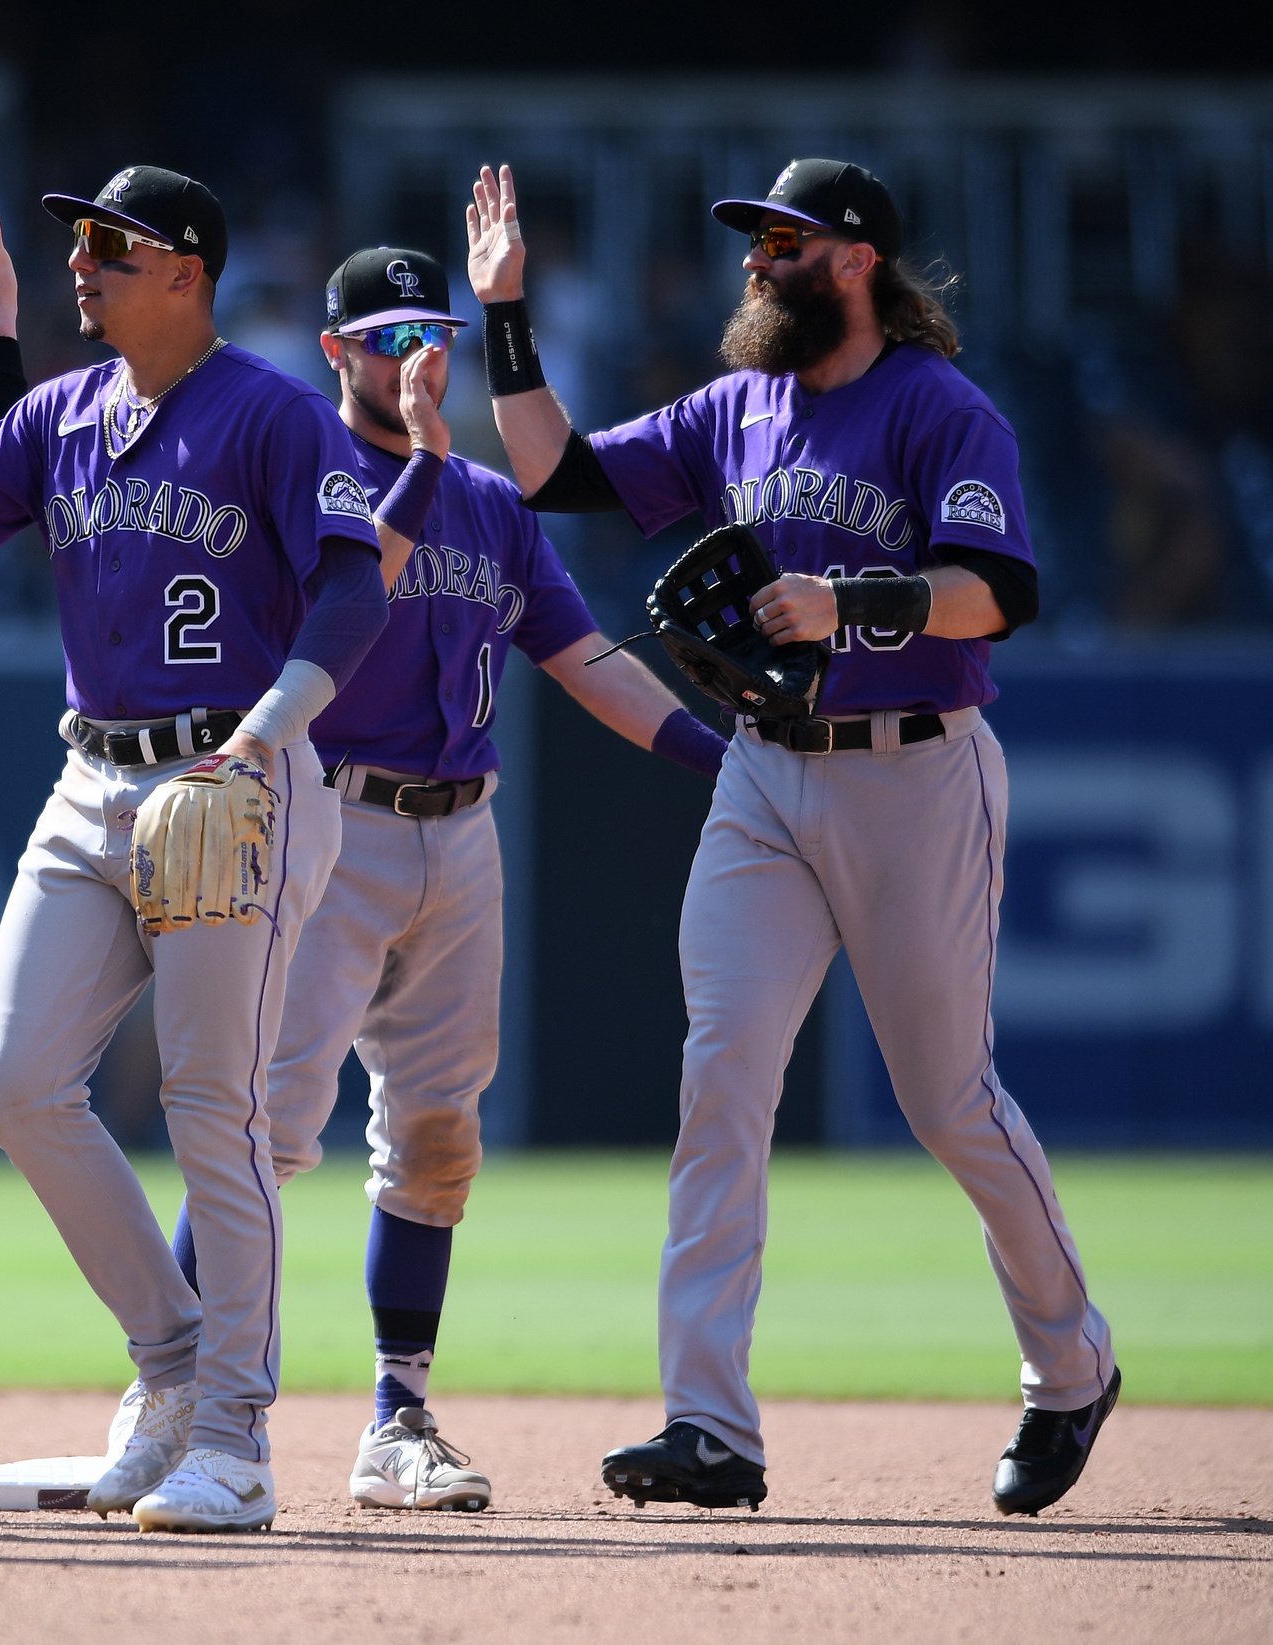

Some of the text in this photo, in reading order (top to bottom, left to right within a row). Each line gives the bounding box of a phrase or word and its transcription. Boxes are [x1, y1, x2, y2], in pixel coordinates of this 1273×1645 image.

[386, 260, 425, 298] CR
[44, 477, 248, 560] OLORADO
[720, 466, 914, 552] OLORADO
[945, 505, 1002, 529] ROCKIES
[950, 484, 1000, 511] COLORADO
[164, 574, 222, 665] 2
[387, 543, 525, 635] LORAO
[471, 642, 493, 728] 1
[200, 728, 213, 744] 2
